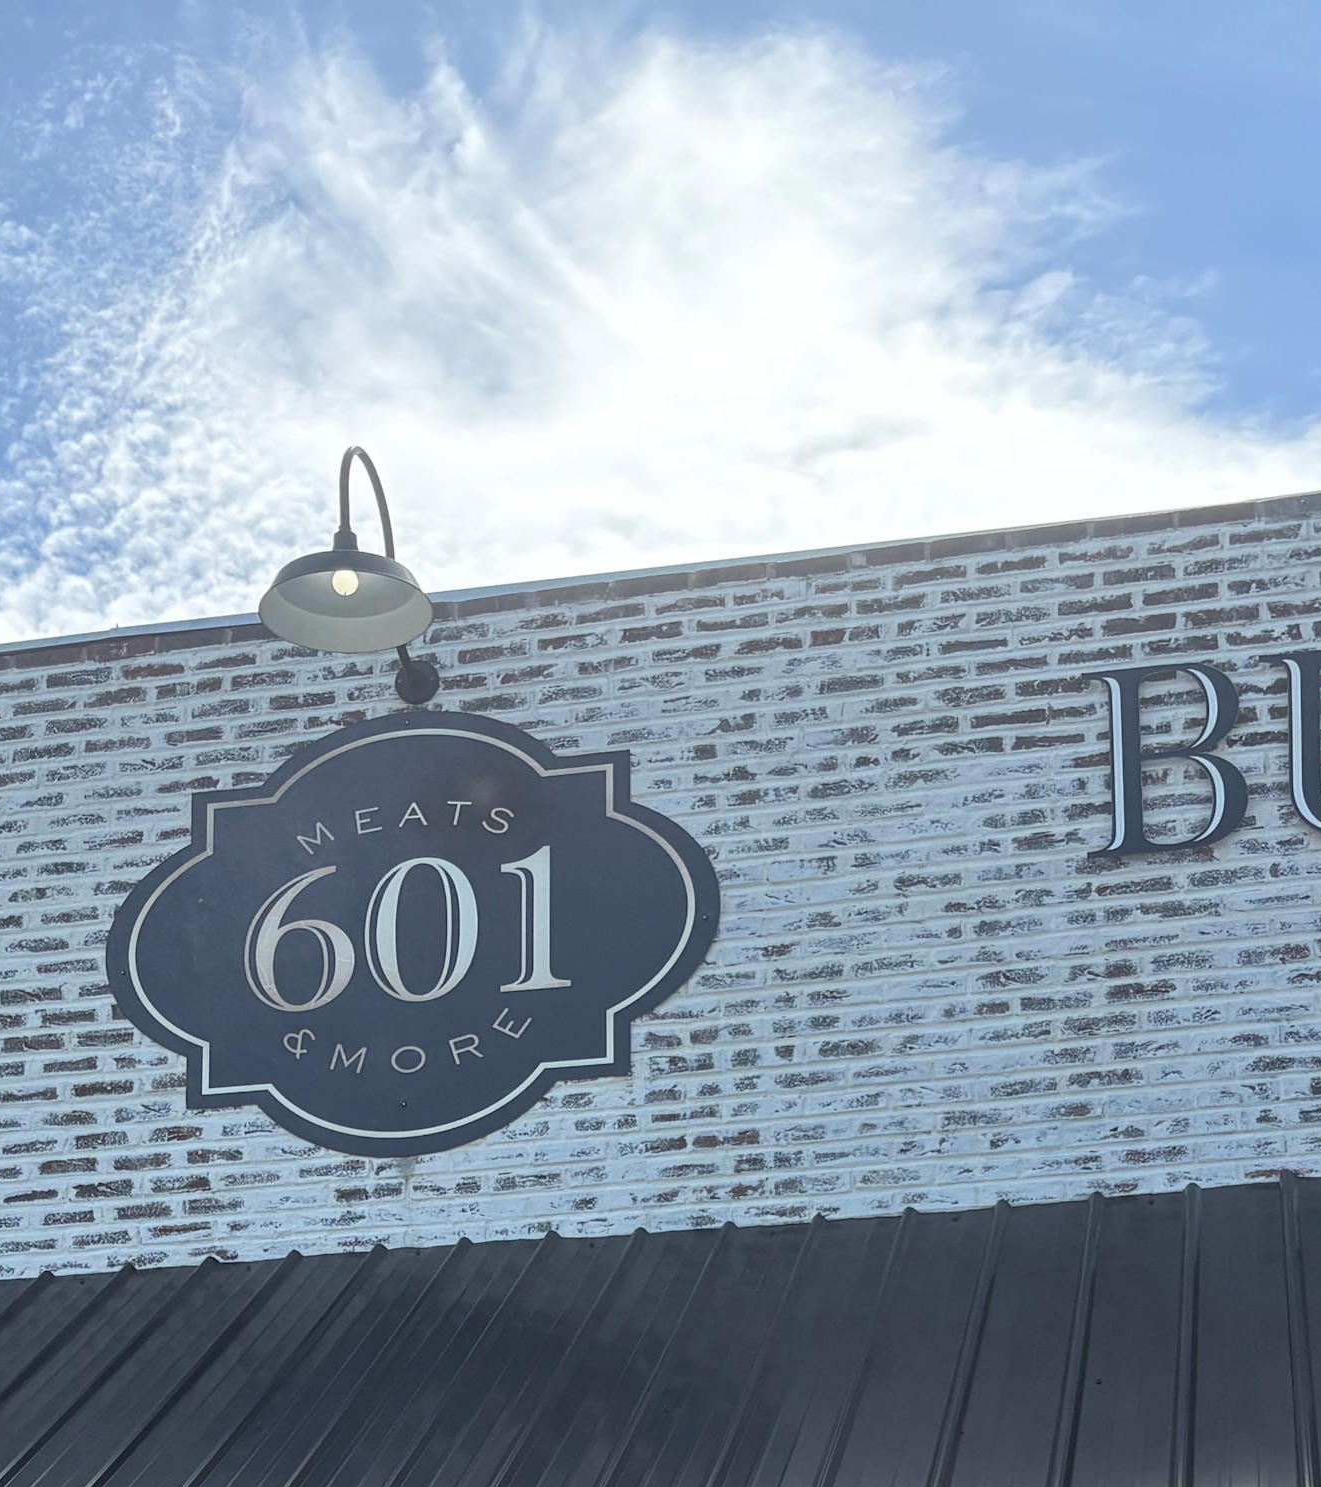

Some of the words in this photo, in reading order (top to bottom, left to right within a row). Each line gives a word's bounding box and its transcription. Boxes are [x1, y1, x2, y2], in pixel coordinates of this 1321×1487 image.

[295, 801, 516, 855] MEATS
[243, 845, 572, 1013] 601
[329, 1007, 533, 1075] MORE
